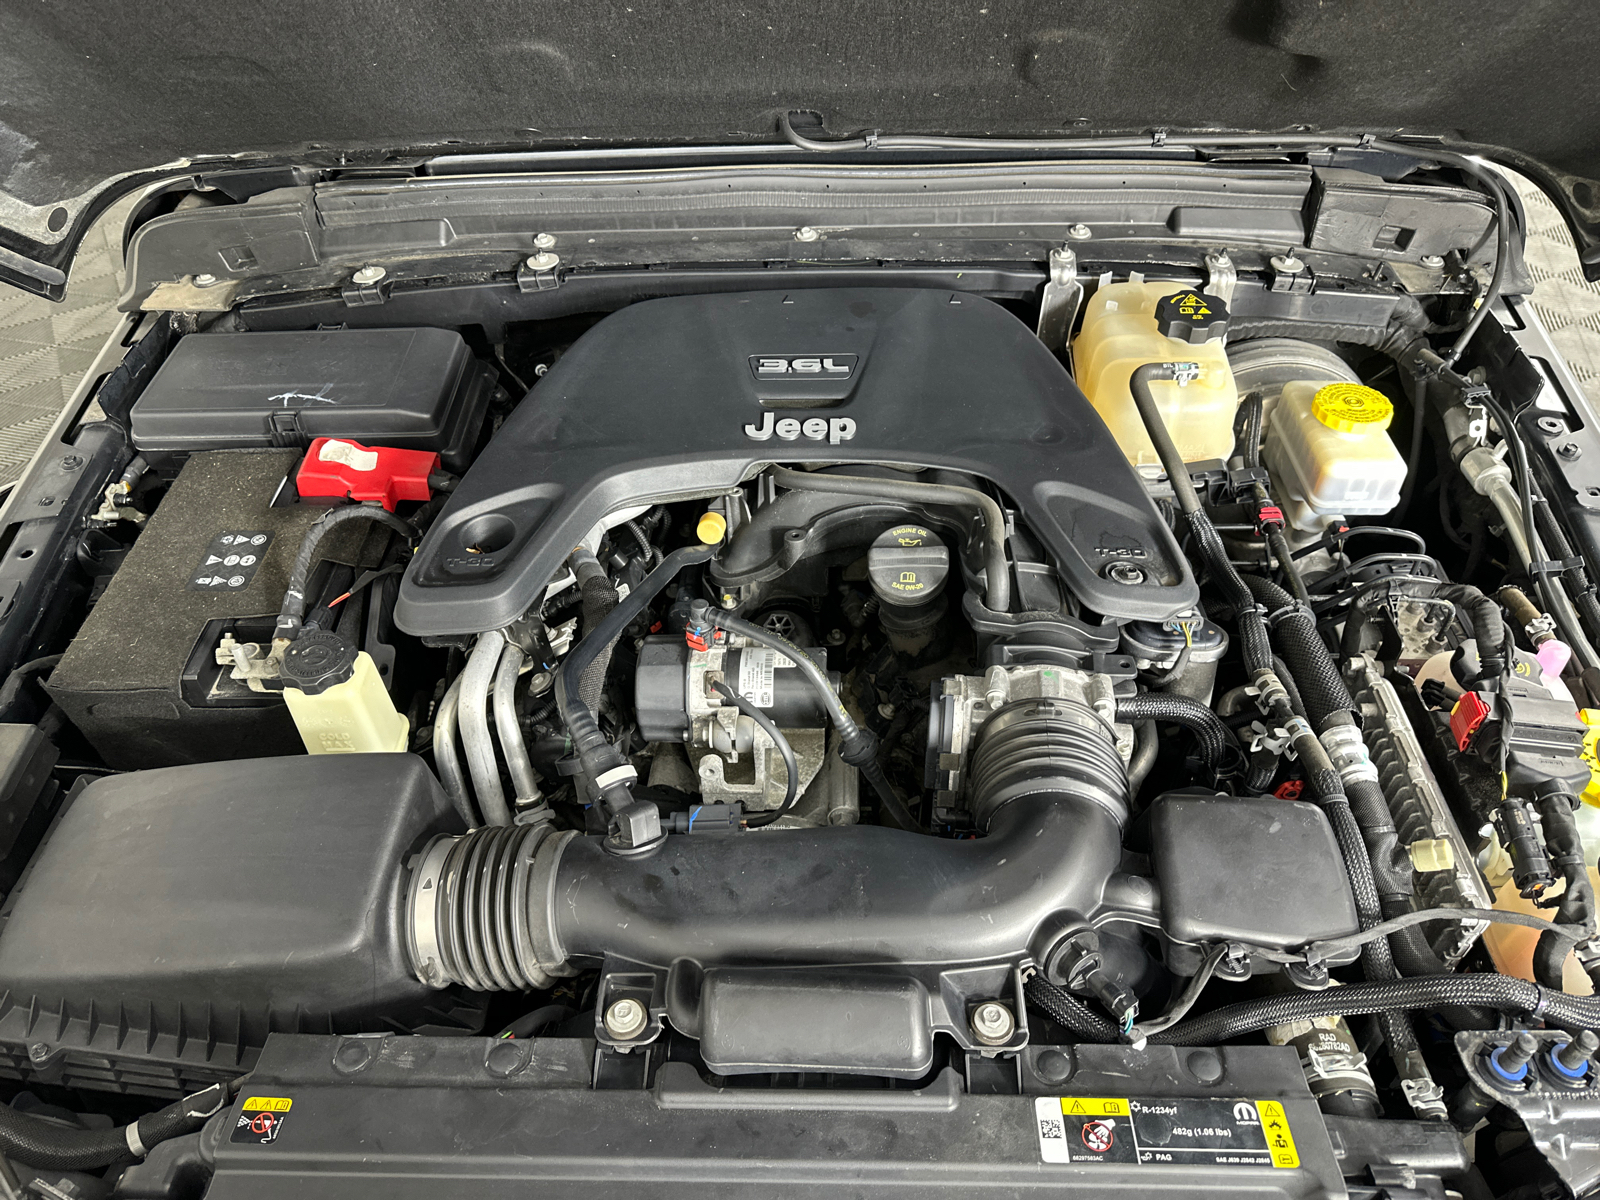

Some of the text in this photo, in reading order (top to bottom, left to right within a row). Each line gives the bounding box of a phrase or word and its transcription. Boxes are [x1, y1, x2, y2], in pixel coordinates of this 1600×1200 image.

[758, 358, 850, 374] 3.6L
[744, 411, 857, 445] Jeep
[892, 528, 916, 536] ENGINE
[1093, 547, 1148, 559] T-30
[446, 557, 495, 567] T-30
[892, 582, 905, 590] SAE
[319, 732, 351, 741] COLD
[321, 740, 355, 749] MAX
[1318, 1033, 1336, 1041] RAD
[1141, 1106, 1178, 1116] R-1234yf
[1172, 1127, 1232, 1138] 482g (1.06 lbs)
[1155, 1153, 1173, 1161] PAG
